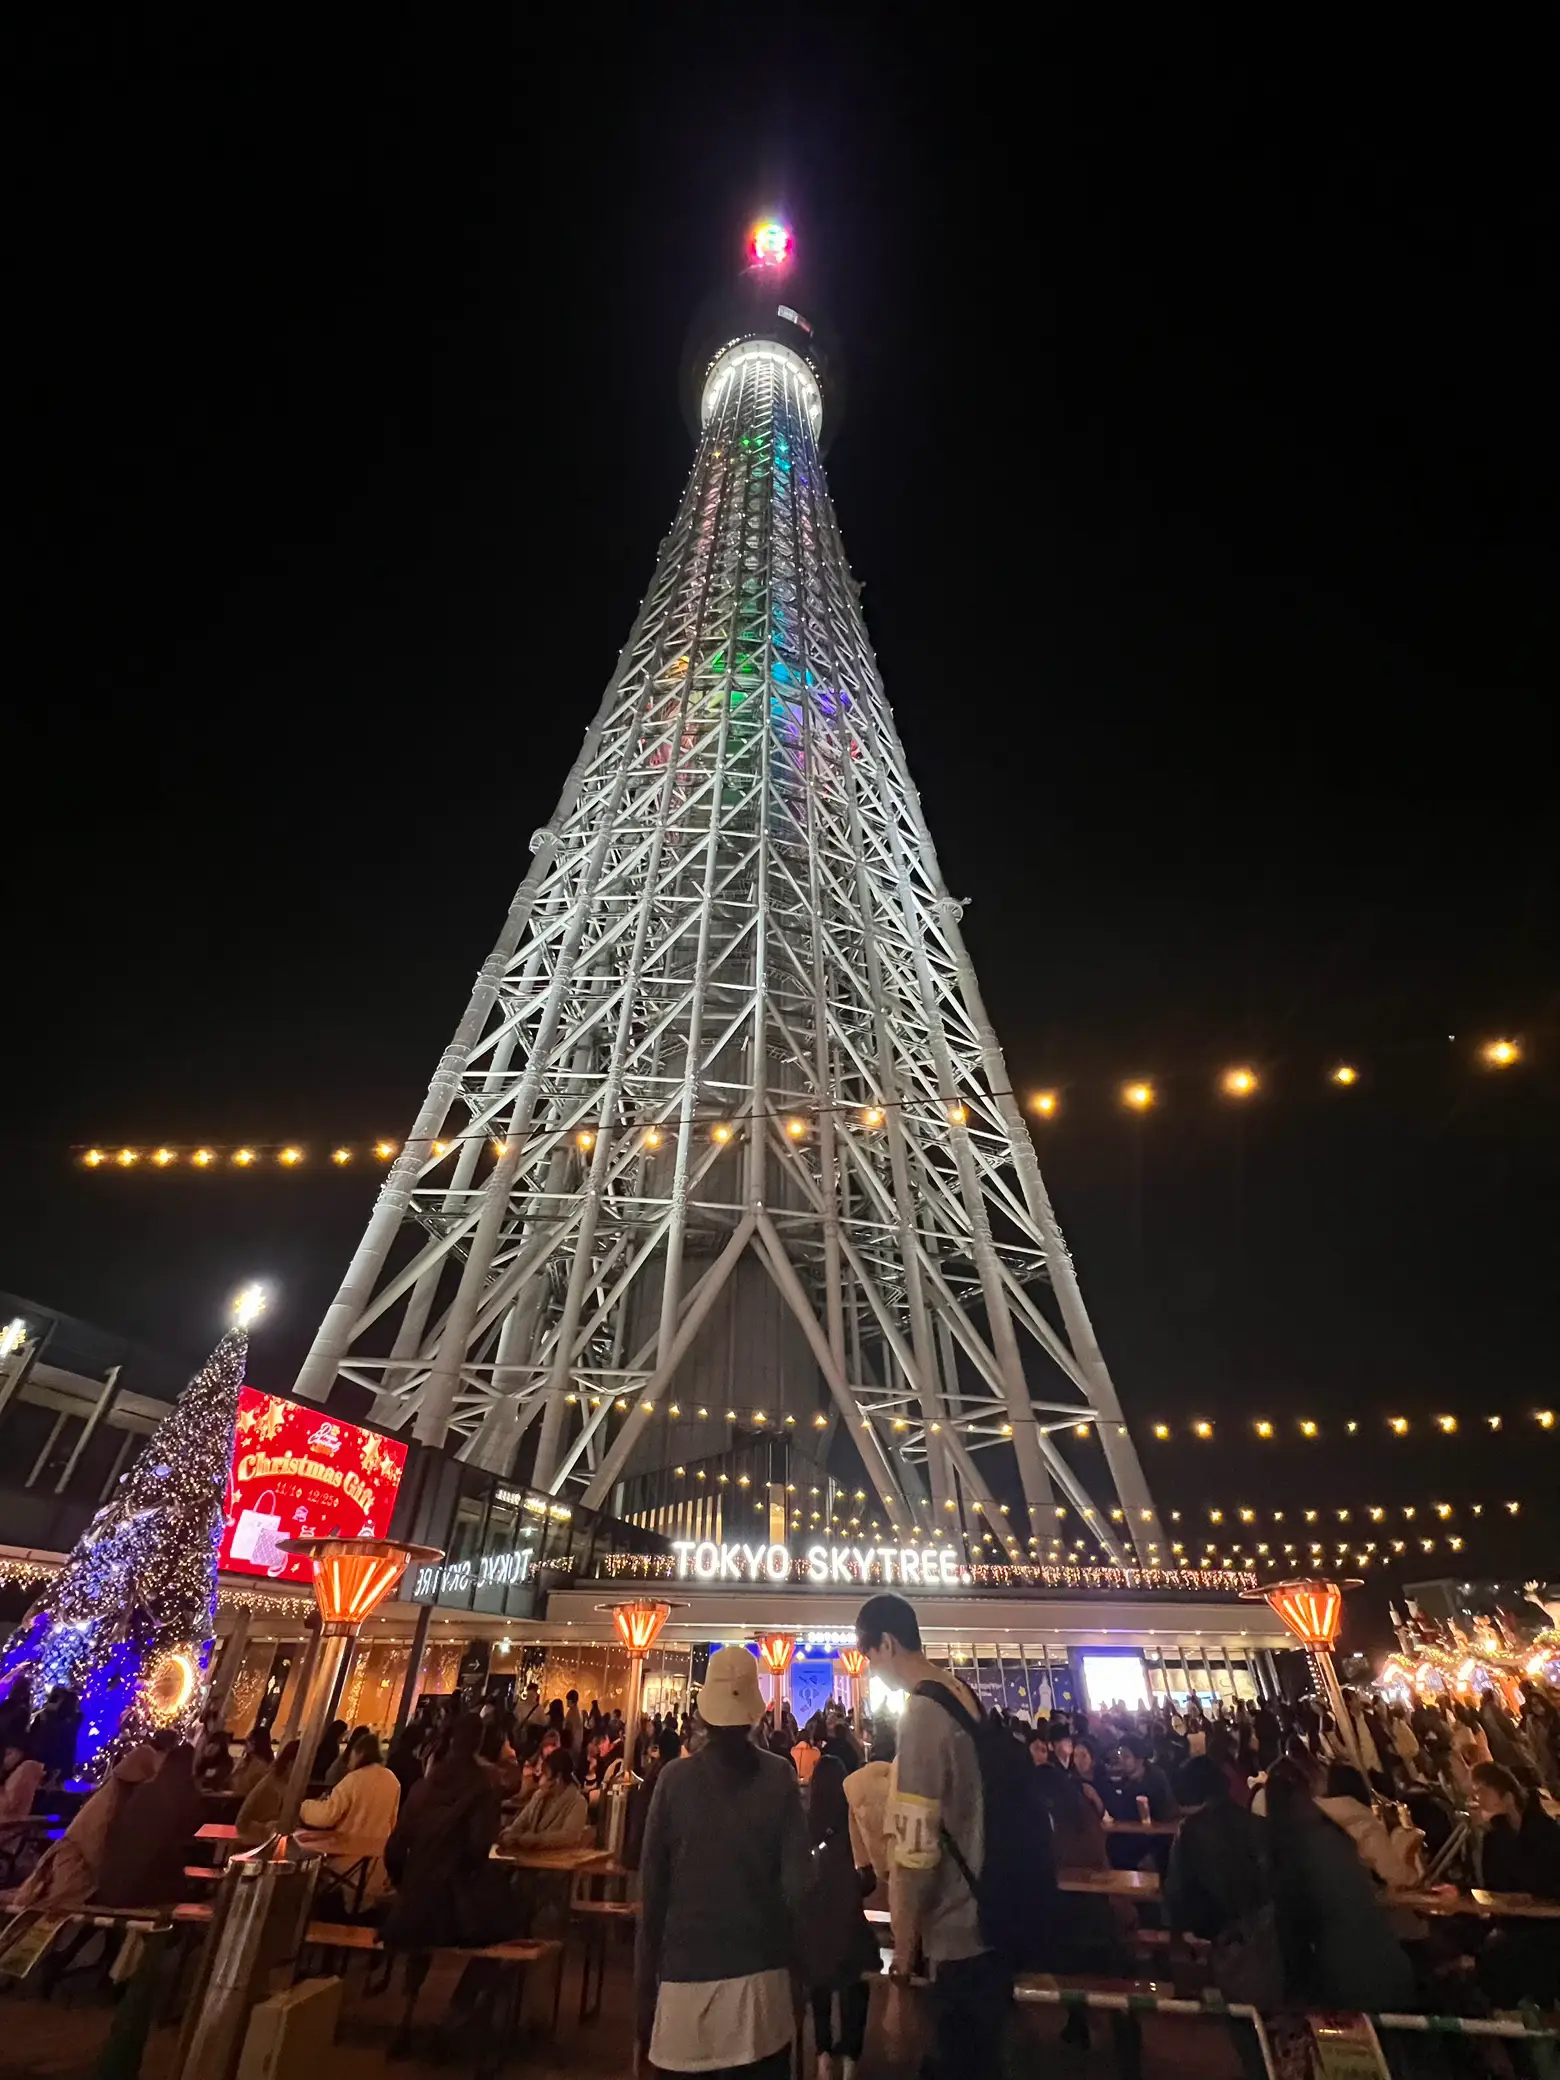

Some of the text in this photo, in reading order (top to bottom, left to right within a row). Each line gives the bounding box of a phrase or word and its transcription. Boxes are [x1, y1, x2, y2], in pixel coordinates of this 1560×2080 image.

[238, 1450, 376, 1516] Christmas Gift
[672, 1541, 959, 1584] TOKYO SKYTREE
